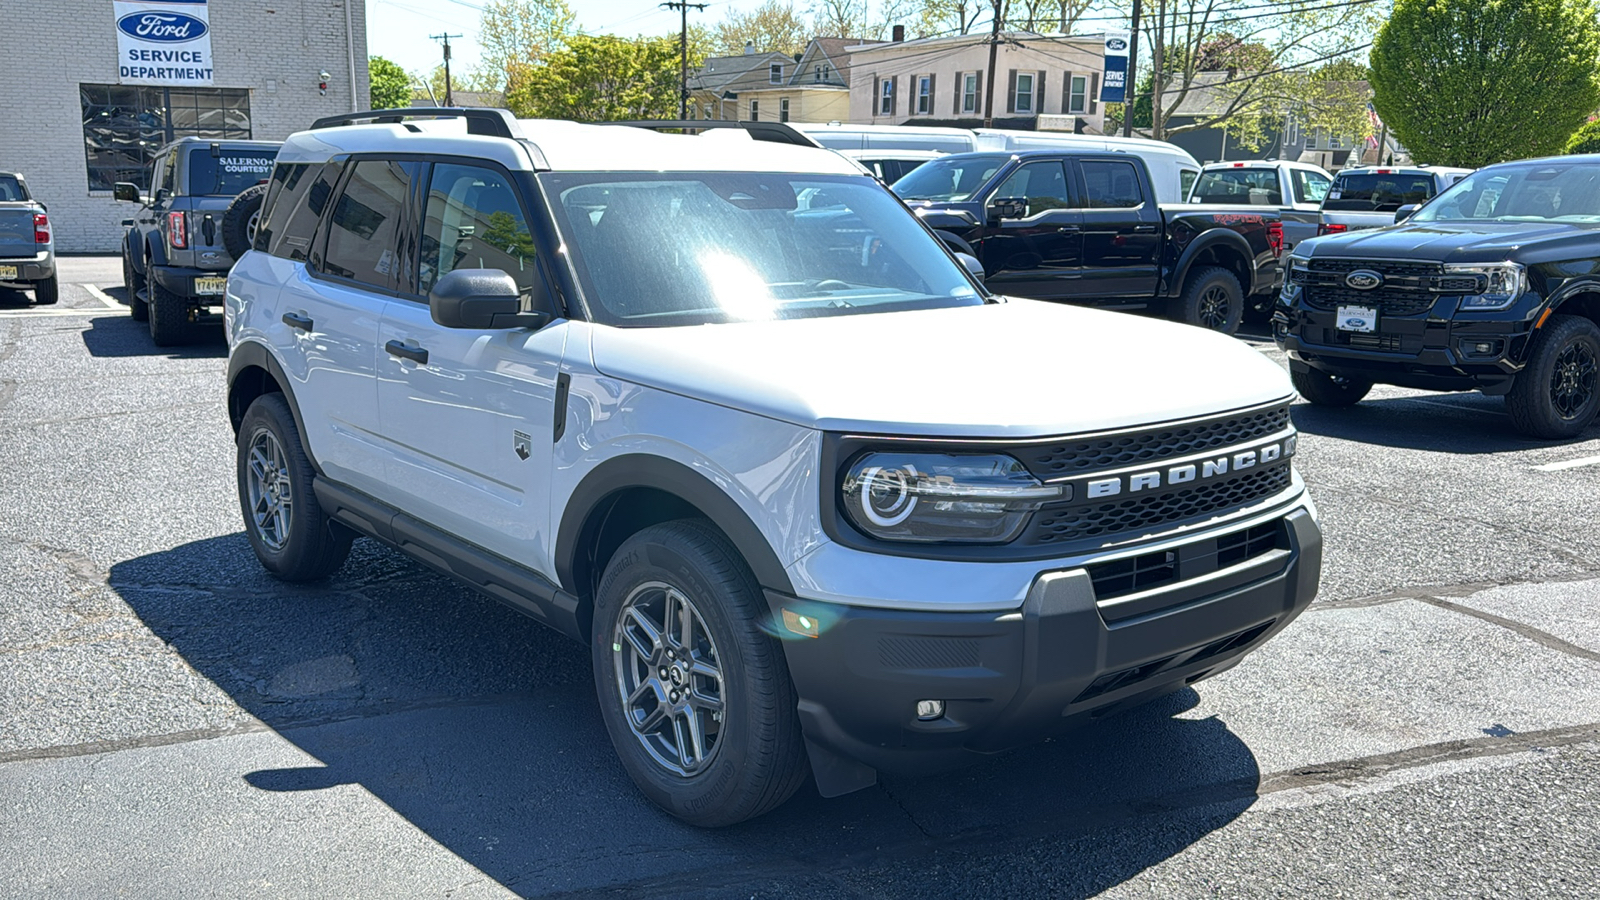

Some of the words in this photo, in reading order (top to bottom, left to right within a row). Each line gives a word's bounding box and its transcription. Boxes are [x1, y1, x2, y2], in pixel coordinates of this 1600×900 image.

[136, 14, 191, 38] Ford
[1109, 40, 1124, 49] Ford
[129, 49, 203, 63] SERVICE
[120, 65, 213, 80] DEPARTMENT
[1105, 71, 1124, 80] SERVICE
[225, 165, 269, 173] COURTESY
[1213, 214, 1265, 226] RAPTOR
[1352, 275, 1371, 285] Ford
[1087, 443, 1280, 499] BRONCO
